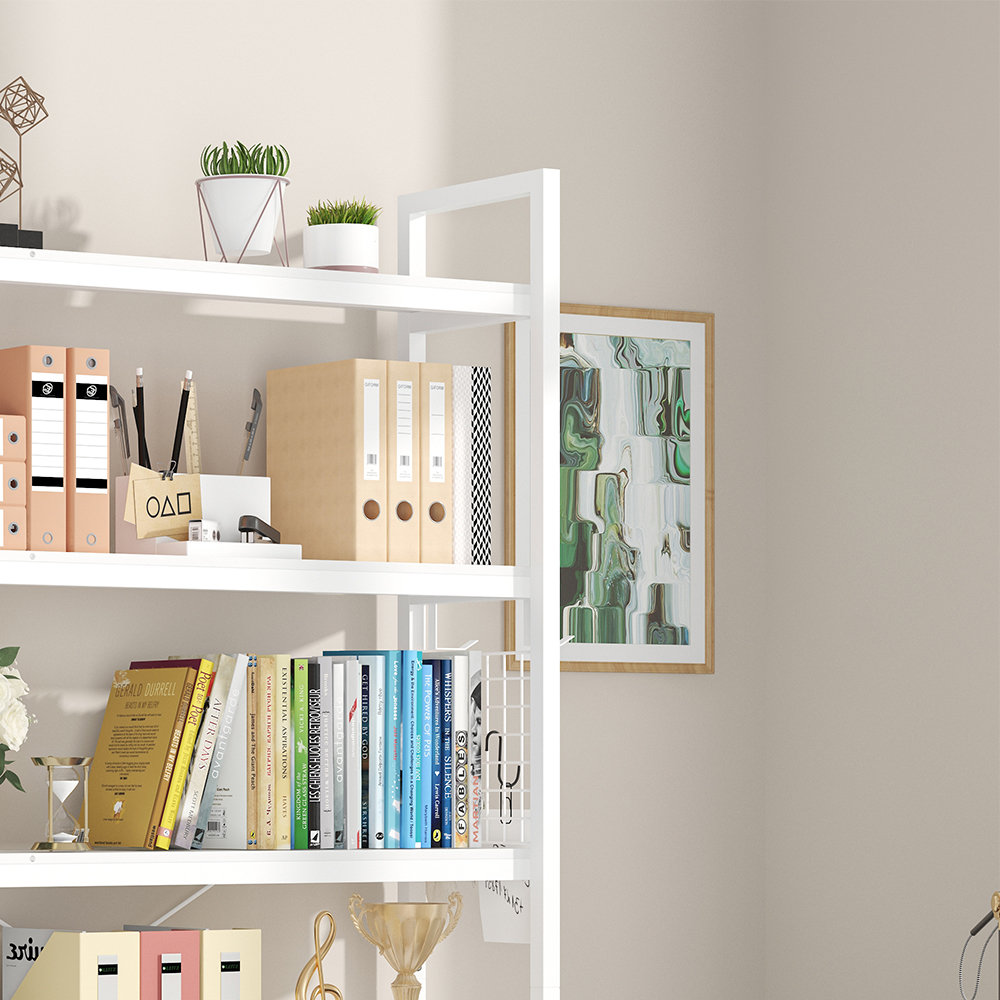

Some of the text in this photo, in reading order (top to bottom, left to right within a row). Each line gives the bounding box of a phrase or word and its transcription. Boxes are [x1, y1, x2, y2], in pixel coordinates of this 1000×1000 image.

[144, 682, 177, 696] DURRELL
[188, 671, 213, 726] Poet Poet
[444, 672, 452, 722] WHISPERS
[206, 698, 222, 736] AFTER
[309, 688, 320, 734] RETROVISEUR
[212, 688, 240, 780] avantgarde
[362, 726, 368, 736] BY
[445, 728, 450, 736] IN
[198, 740, 215, 770] DAYS
[309, 764, 320, 790] CHIENS
[309, 790, 320, 802] LES
[444, 756, 452, 800] SILENCE
[458, 734, 466, 832] FABLES
